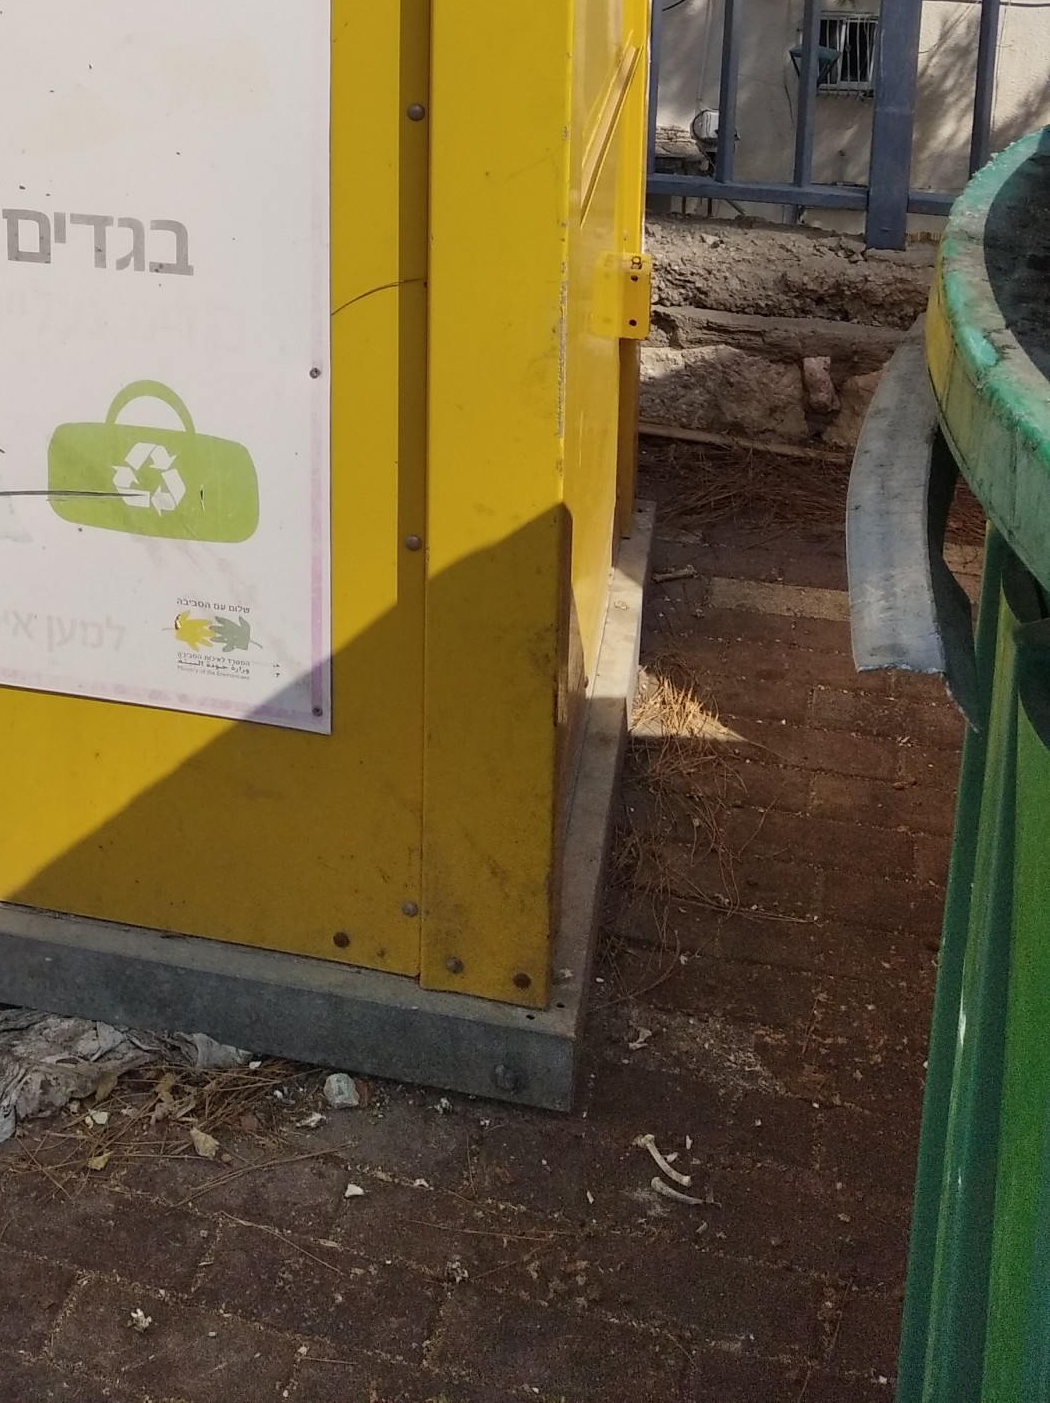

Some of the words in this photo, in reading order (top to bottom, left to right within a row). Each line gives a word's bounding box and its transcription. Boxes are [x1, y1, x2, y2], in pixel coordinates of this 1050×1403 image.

[1, 207, 195, 276] בגדים
[176, 597, 211, 609] הסביבה
[213, 603, 226, 611] עם
[228, 604, 251, 614] שלום
[45, 614, 127, 653] למען
